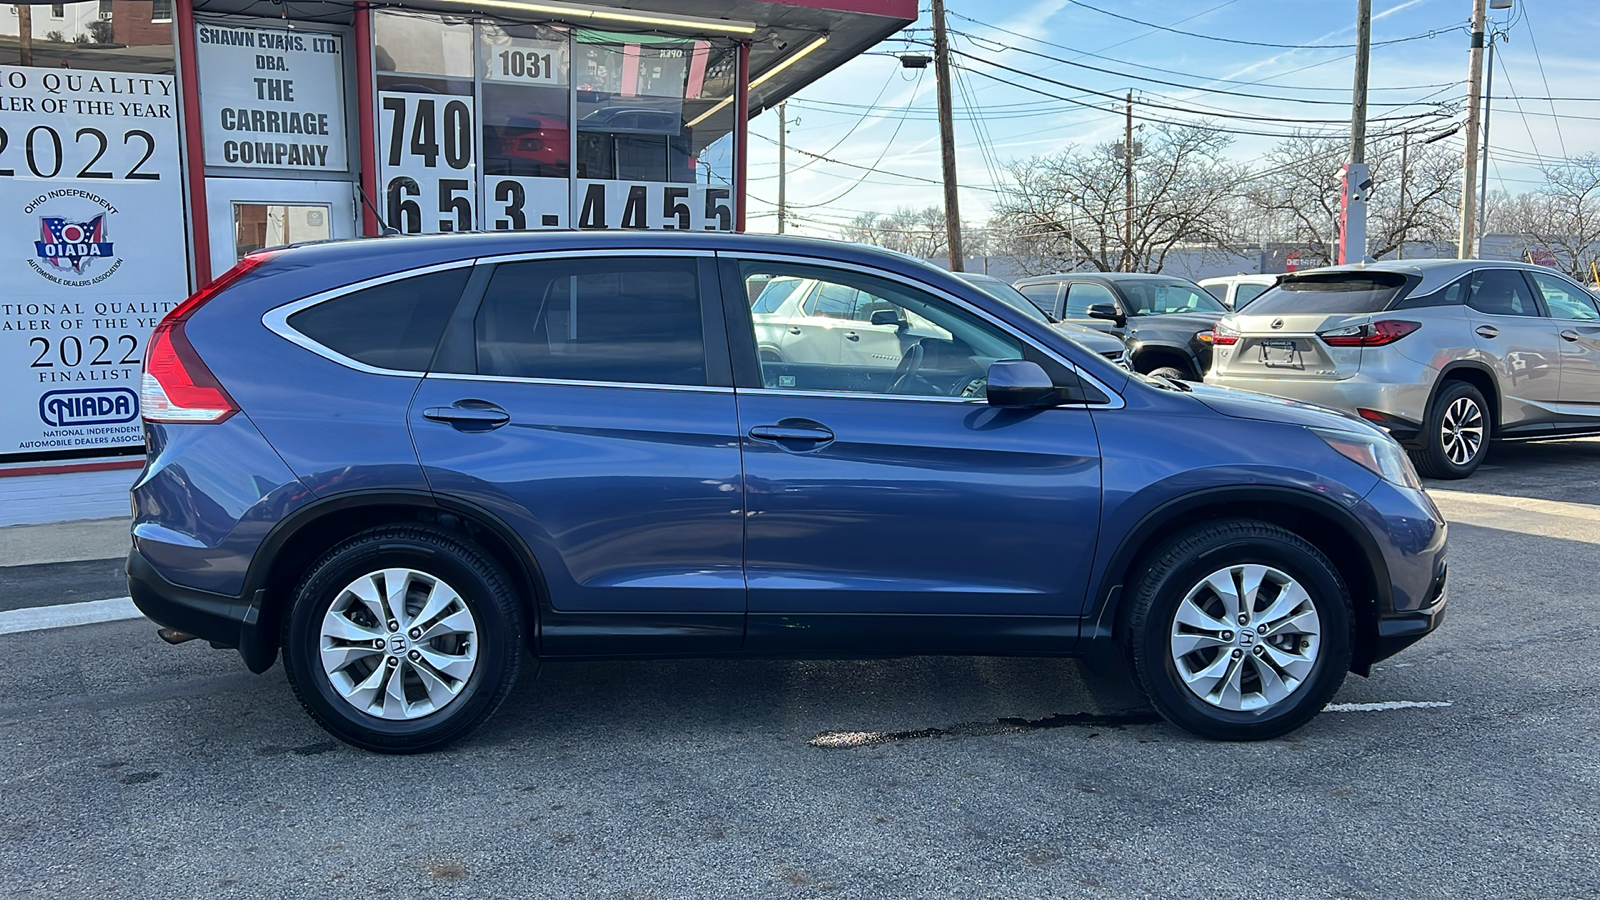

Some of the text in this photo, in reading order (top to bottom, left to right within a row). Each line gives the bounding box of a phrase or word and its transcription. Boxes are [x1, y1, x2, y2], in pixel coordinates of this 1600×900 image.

[200, 28, 254, 47] SHAWN
[313, 38, 340, 54] LTD.
[256, 55, 289, 71] DBA.
[499, 50, 551, 79] 1031
[43, 73, 173, 97] QUALITY
[254, 78, 294, 102] THE
[41, 98, 68, 114] OF
[73, 100, 115, 116] THE
[119, 102, 172, 118] YEAR
[221, 108, 329, 135] CARRIAGE
[383, 97, 471, 170] 740
[224, 140, 329, 166] COMPANY
[24, 188, 119, 216] OHIO INDEPENDENT
[44, 243, 101, 257] OIADA
[26, 257, 124, 287] AUTOMOBILE DEALERS ASSOCIATION
[1, 303, 85, 316] TIONAL
[2, 319, 51, 331] ALER
[60, 319, 83, 330] OF
[92, 318, 129, 329] THE
[29, 334, 141, 368] 2022
[39, 369, 132, 383] FINALIST
[48, 395, 130, 419] NIADA
[19, 438, 72, 449] AUTOMOBILE
[74, 436, 109, 446] DEALERS
[43, 425, 141, 438] NATIONAL INDEPENDENT
